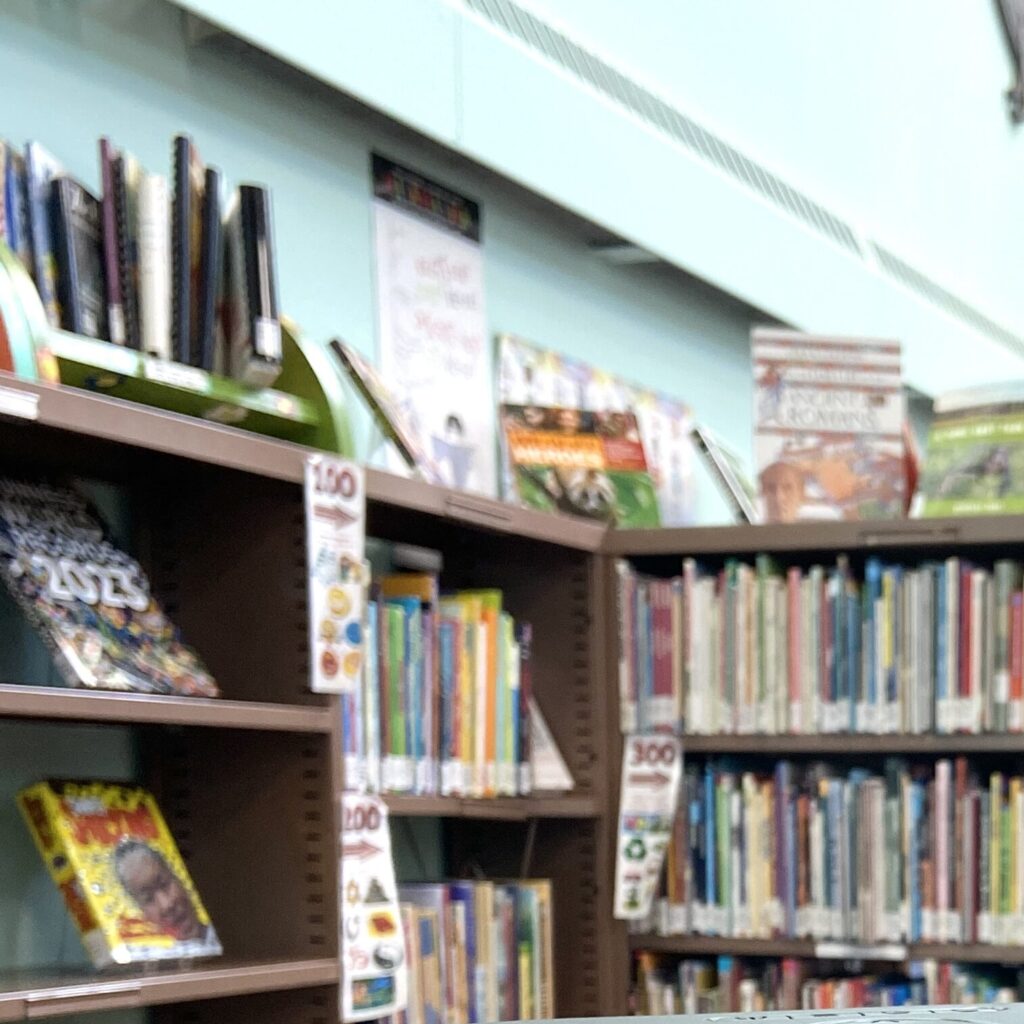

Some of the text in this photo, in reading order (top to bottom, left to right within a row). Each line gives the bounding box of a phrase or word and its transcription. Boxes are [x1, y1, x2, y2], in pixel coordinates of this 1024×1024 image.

[312, 464, 358, 499] 100
[32, 553, 151, 612] 2023
[631, 740, 677, 767] 300
